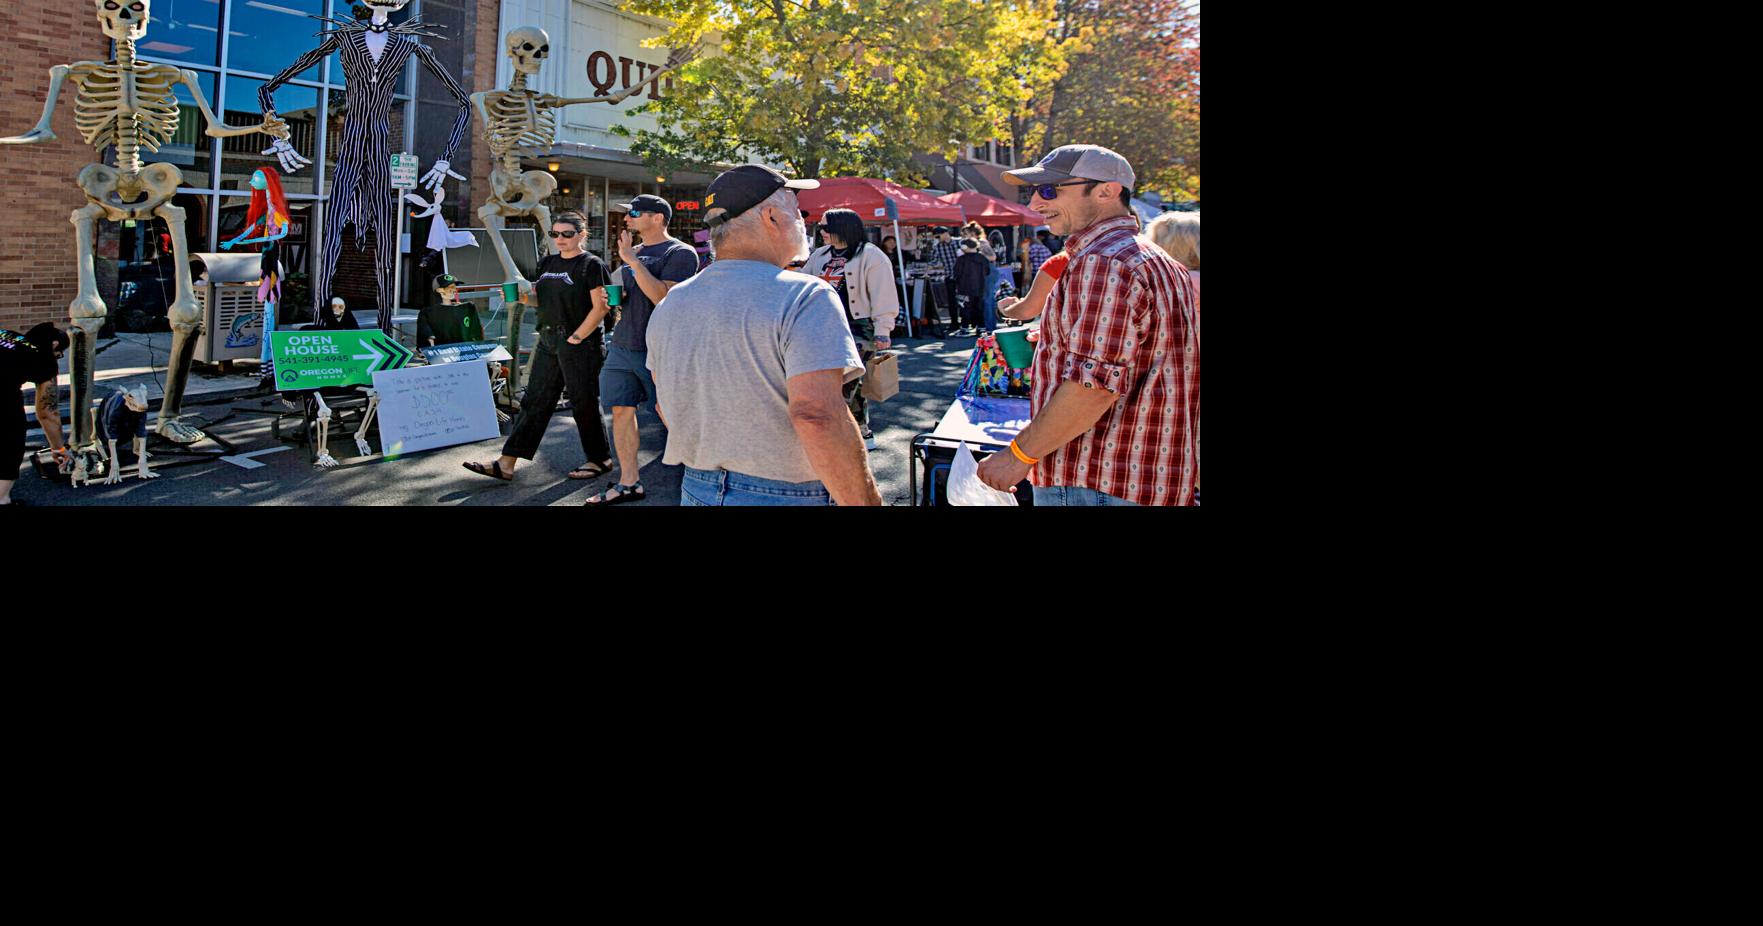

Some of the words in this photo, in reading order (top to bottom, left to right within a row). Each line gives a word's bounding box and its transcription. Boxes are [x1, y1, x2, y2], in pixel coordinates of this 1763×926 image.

[393, 157, 399, 165] 2
[676, 201, 699, 210] OPEN
[288, 336, 332, 345] OPEN
[285, 345, 339, 355] HOUSE
[279, 355, 349, 364] 541-391-4945
[300, 368, 343, 376] OREGON
